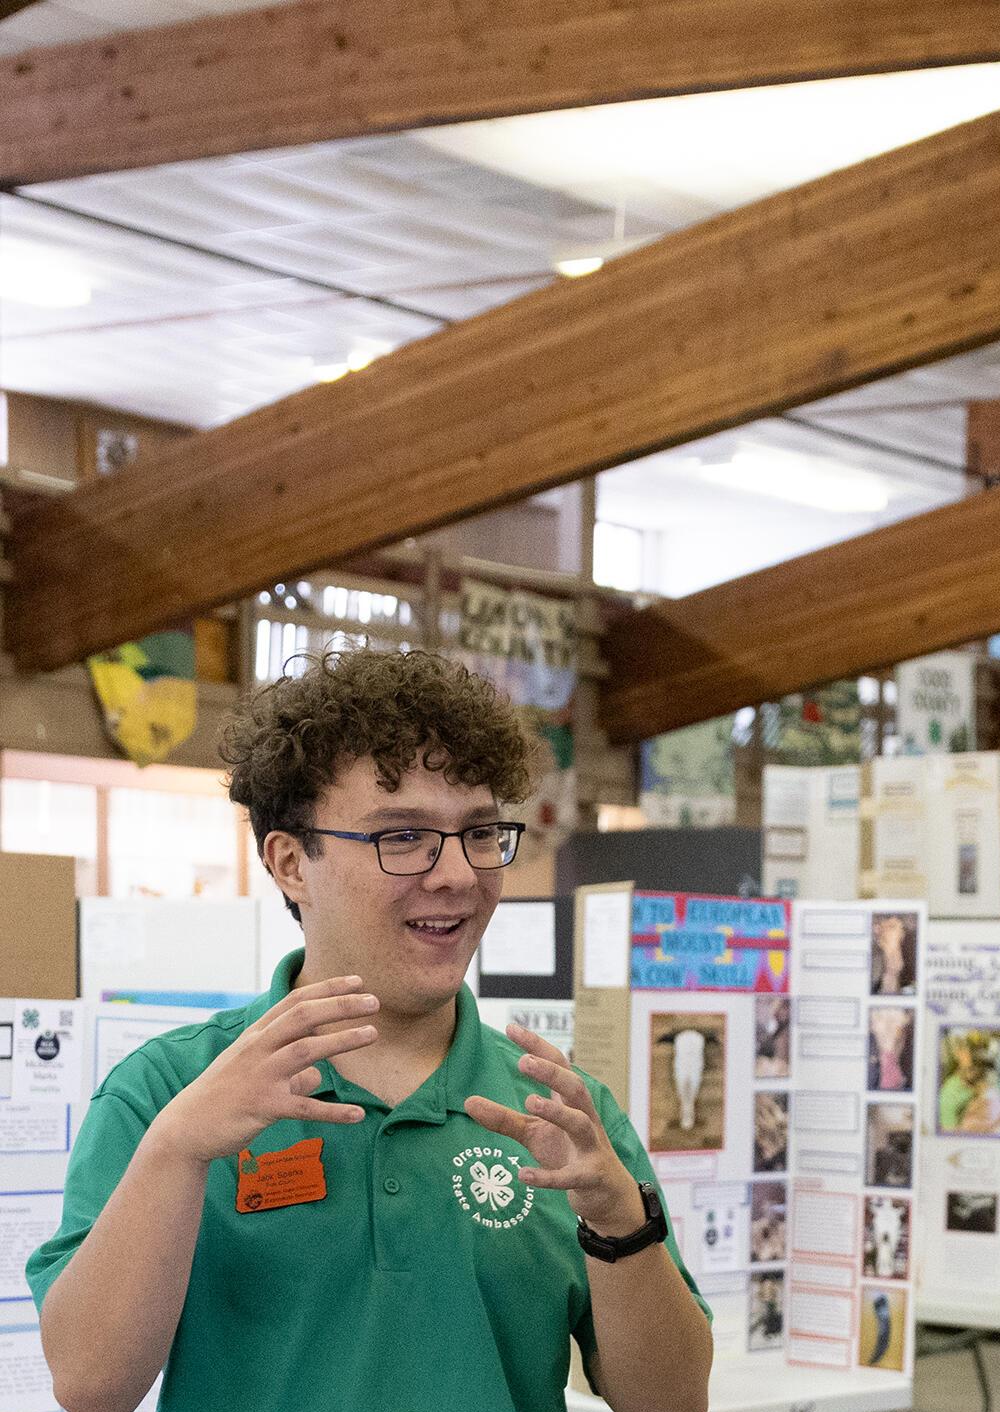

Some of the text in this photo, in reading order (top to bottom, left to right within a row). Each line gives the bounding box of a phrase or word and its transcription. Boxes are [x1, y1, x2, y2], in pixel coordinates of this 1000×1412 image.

[511, 1008, 574, 1031] SECRE
[453, 1146, 522, 1169] Oregon 4-
[452, 1174, 535, 1229] State Ambassador
